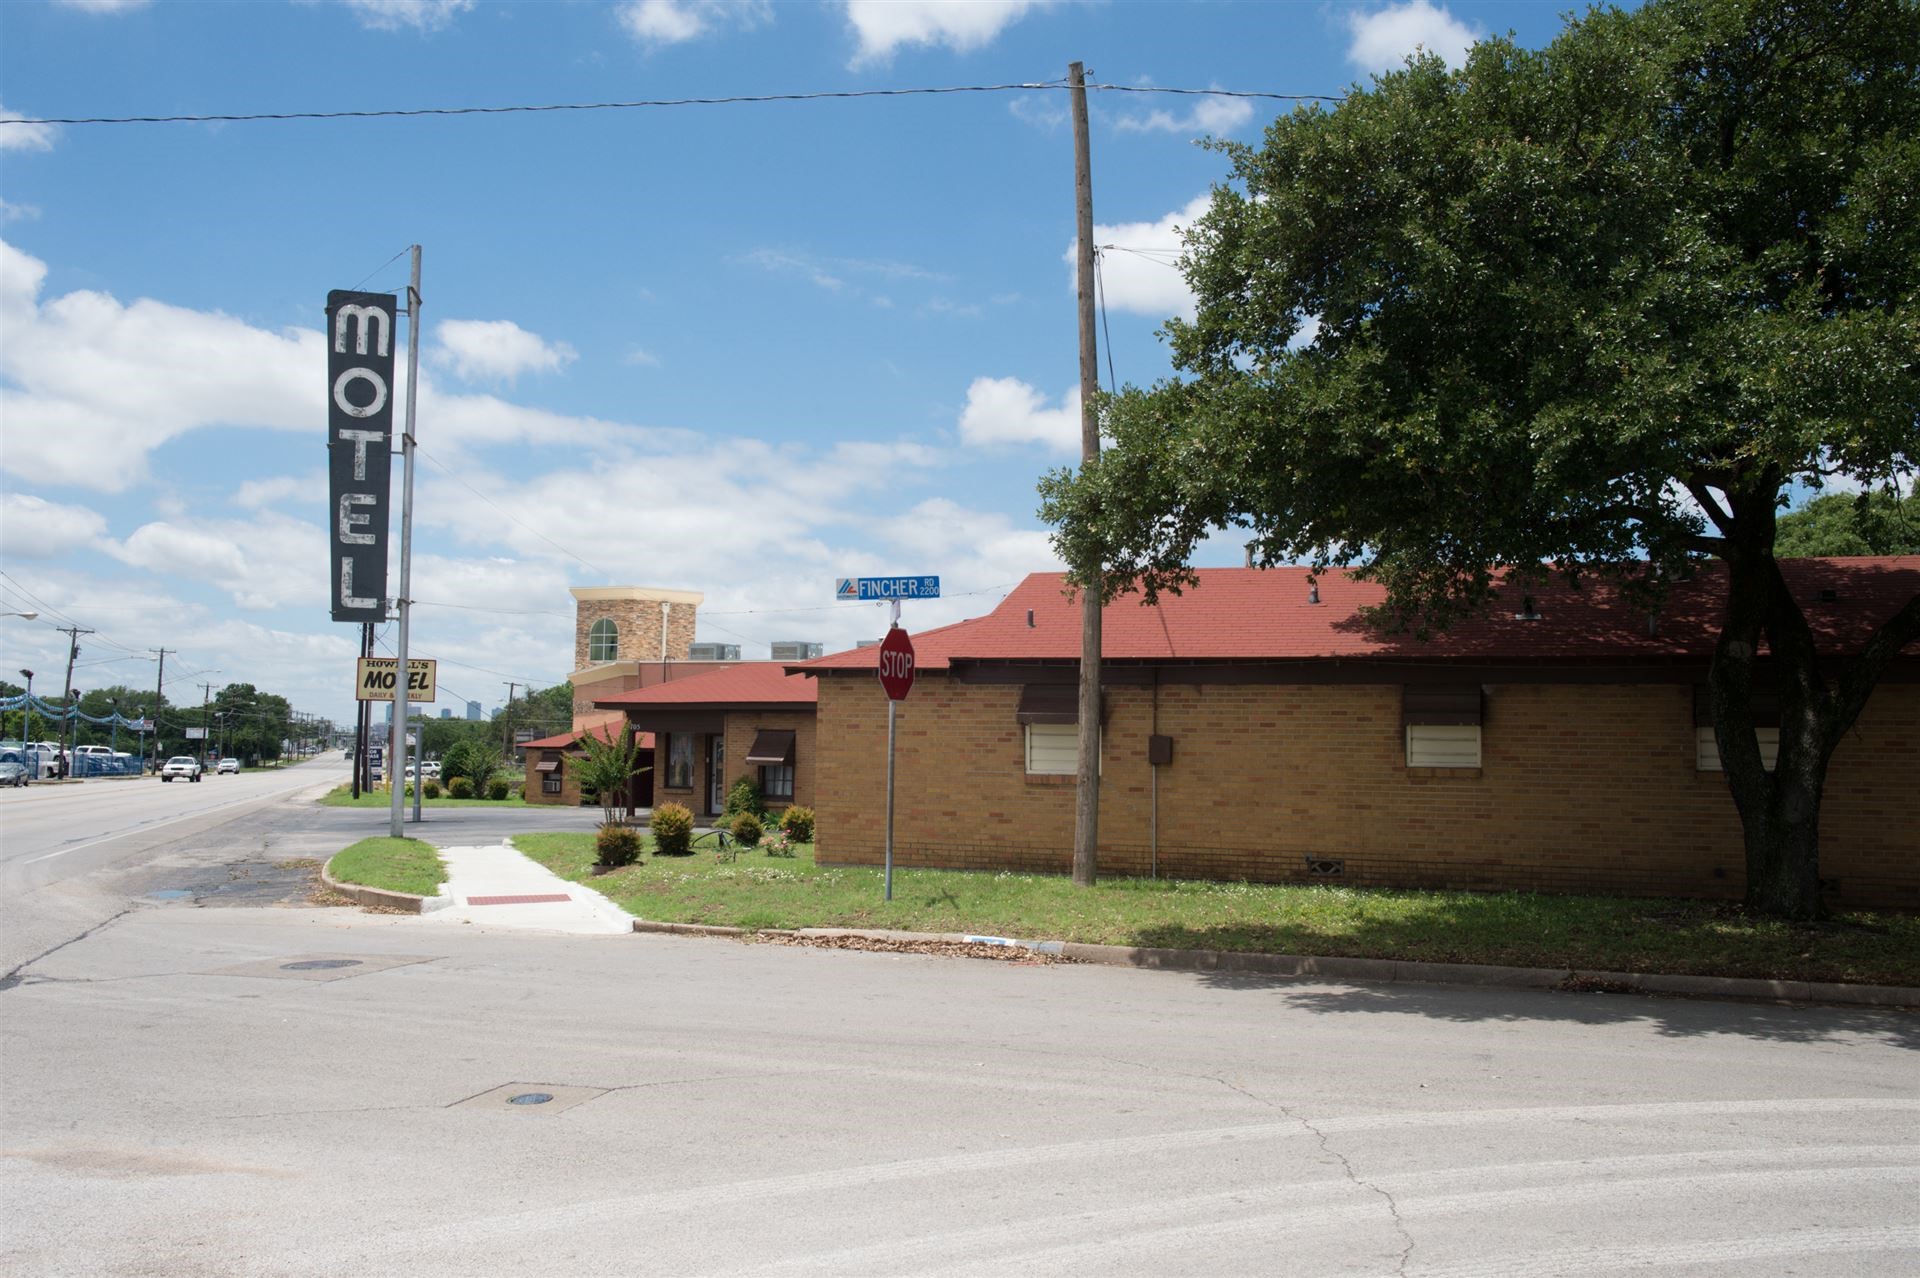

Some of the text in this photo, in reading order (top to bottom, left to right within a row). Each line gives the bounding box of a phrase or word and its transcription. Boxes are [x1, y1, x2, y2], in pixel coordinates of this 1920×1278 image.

[333, 303, 391, 609] MOTEL
[860, 578, 934, 597] FINCHER RD
[920, 586, 939, 596] 2200
[366, 660, 429, 670] HOWL'S
[881, 650, 913, 679] STOP
[363, 670, 429, 690] MOEL
